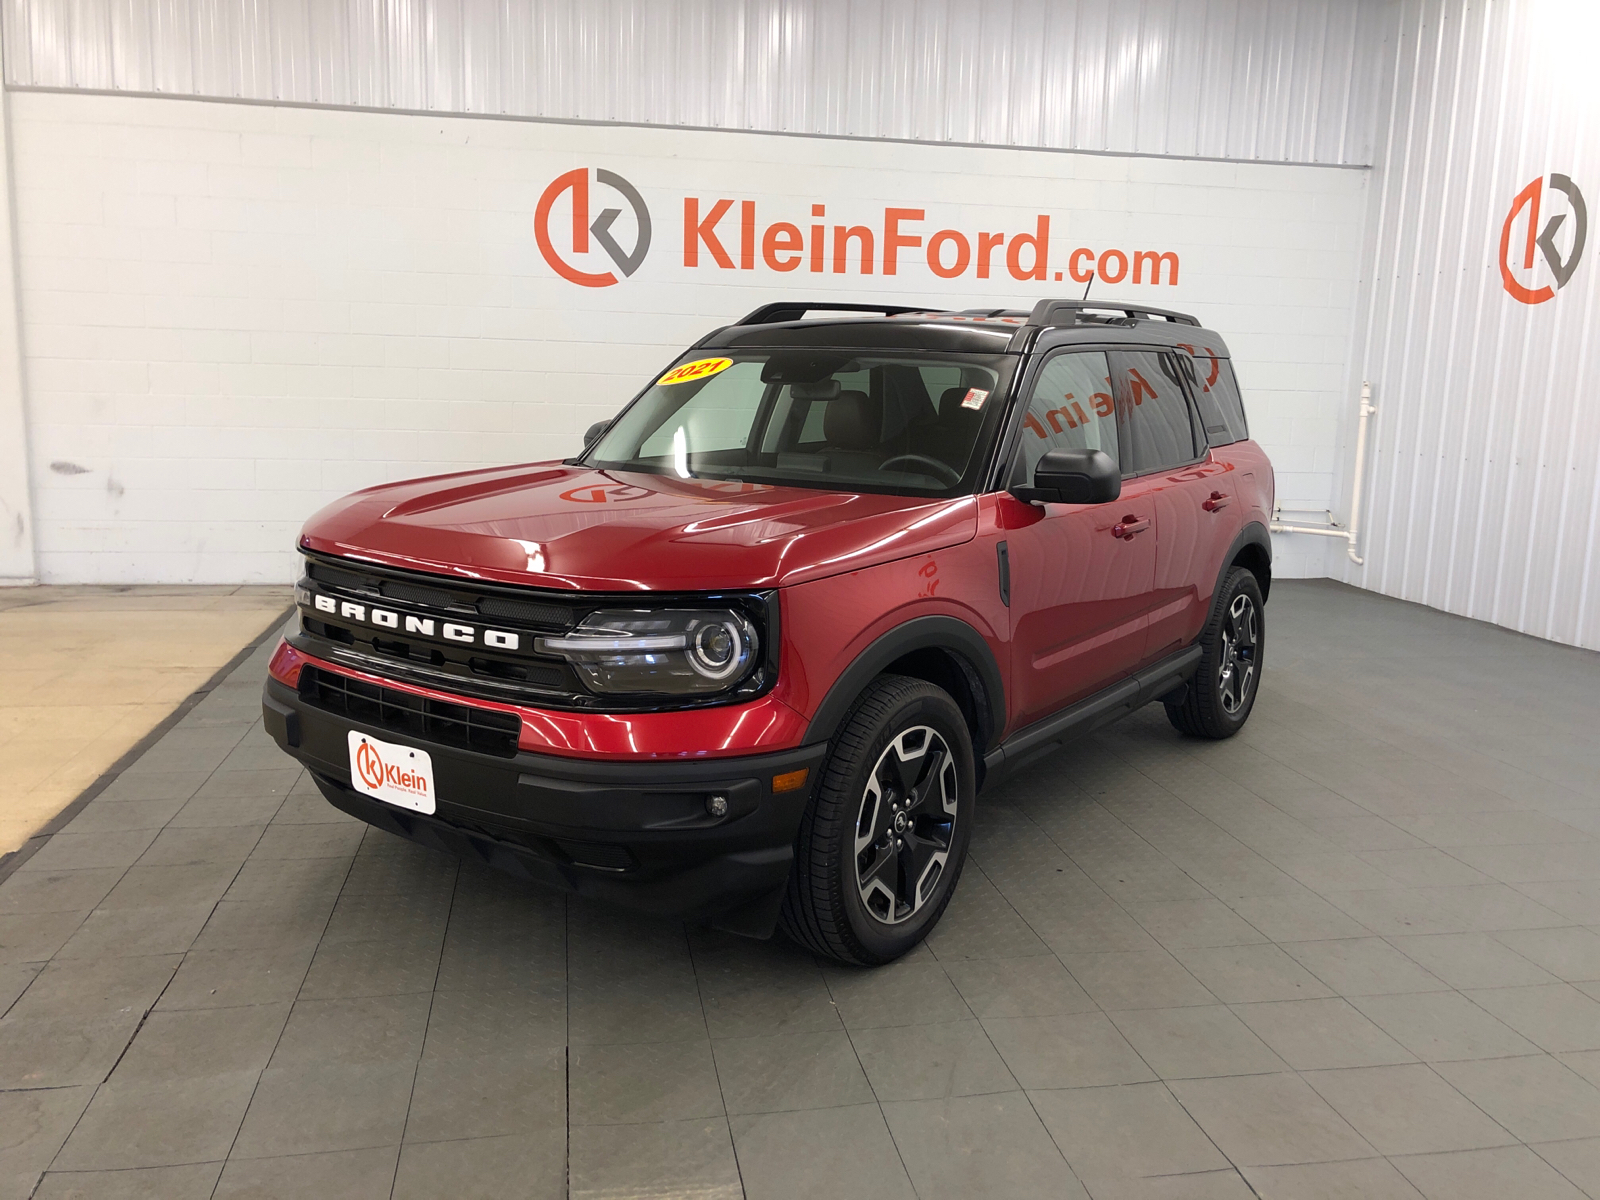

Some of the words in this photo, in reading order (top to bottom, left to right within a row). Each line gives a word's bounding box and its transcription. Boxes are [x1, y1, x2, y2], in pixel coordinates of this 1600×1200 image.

[683, 197, 1180, 286] KleinFord.com
[662, 360, 725, 382] 2021
[314, 594, 520, 651] BRONCO
[384, 763, 427, 791] Klein
